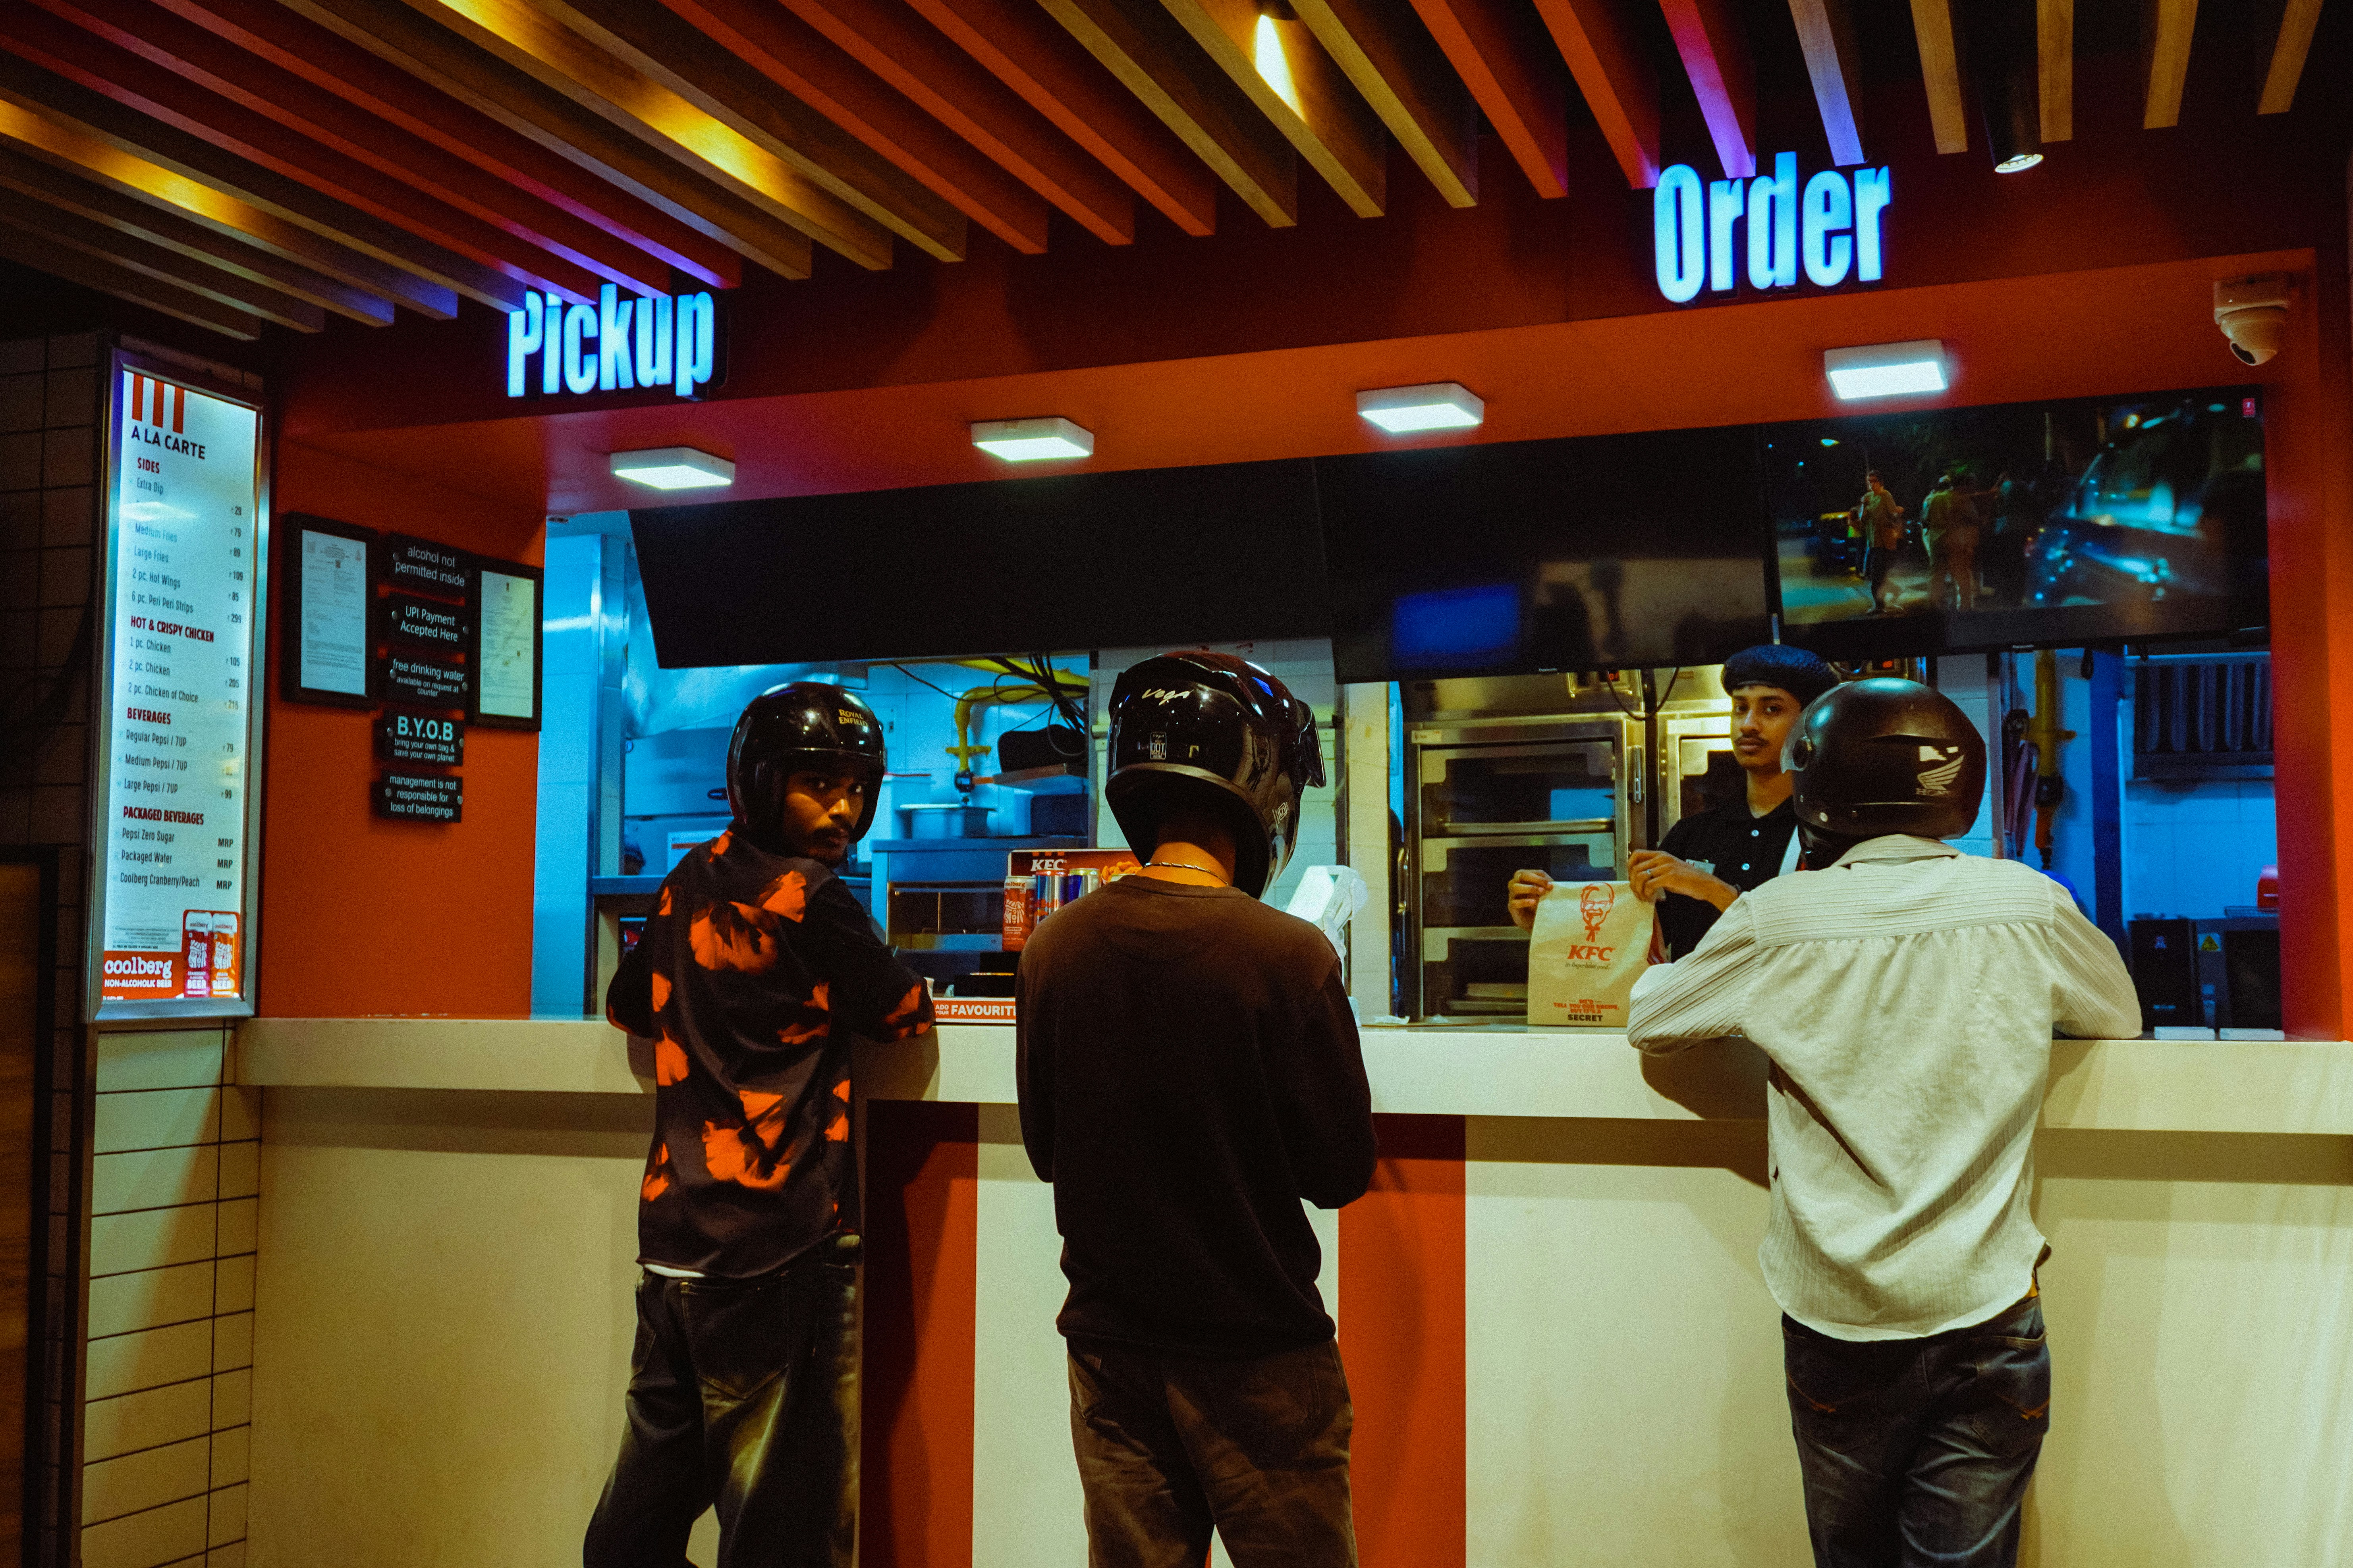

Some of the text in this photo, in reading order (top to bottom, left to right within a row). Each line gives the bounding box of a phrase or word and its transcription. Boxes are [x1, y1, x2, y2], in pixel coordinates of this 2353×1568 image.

[1654, 151, 1890, 303] Order
[508, 283, 714, 397] Pickup
[131, 425, 206, 460] A LA CARTE
[137, 457, 160, 474] SIDES
[137, 477, 164, 496] Extra Dip
[135, 523, 178, 542] Medium Fries
[134, 545, 169, 563] Large Fries
[407, 546, 455, 567] alcohol not
[133, 568, 136, 579] 2
[149, 572, 160, 583] Hot
[162, 574, 181, 590] Wings
[395, 561, 465, 587] permitted inside
[132, 591, 135, 601] 6
[149, 594, 160, 606] Peri
[162, 597, 174, 610] Peri
[176, 600, 193, 615] Strips
[405, 605, 455, 626] UPI Payment
[131, 615, 214, 643] HOT & CRISPY CHICKEN
[400, 620, 458, 642] Accepted Here
[130, 636, 133, 647] 1
[146, 639, 171, 654] Chicken
[129, 659, 133, 670] 2
[146, 662, 170, 676] Chicken
[393, 658, 465, 681] free drinking water
[128, 682, 132, 692] 2
[145, 685, 170, 699] Chicken
[171, 689, 178, 700] of
[179, 690, 198, 703] Choice
[396, 676, 422, 687] available
[432, 683, 452, 692] request
[417, 688, 438, 698] counter
[127, 707, 171, 725] BEVERAGES
[838, 709, 864, 719] ROYAL
[838, 716, 869, 727] ENFIELD
[126, 729, 150, 743] Regular
[152, 733, 169, 746] Pepsi
[176, 736, 187, 747] 7UP
[397, 716, 454, 742] B.Y.O.B
[394, 738, 409, 749] bring
[411, 741, 423, 750] your
[438, 743, 449, 754] bag
[450, 744, 455, 753] &
[125, 754, 151, 767] Medium
[153, 757, 170, 770] Pepsi
[176, 760, 187, 771] 7UP
[410, 751, 423, 759] your
[437, 753, 454, 763] planet
[124, 778, 141, 792] Large
[143, 780, 160, 794] Pepsi
[167, 783, 178, 794] 7UP
[390, 775, 456, 790] management is not
[397, 790, 449, 802] responsible for
[123, 806, 204, 825] PACKAGED BEVERAGES
[390, 801, 454, 819] loss of belongings
[122, 827, 174, 845] Pepsi Zero Sugar
[218, 837, 234, 848] MRP
[122, 849, 172, 864] Packaged Water
[217, 859, 233, 868] MRP
[1030, 859, 1066, 872] KFC
[120, 872, 148, 887] Coolberg
[216, 880, 232, 890] MRP
[1567, 945, 1614, 961] KFC
[104, 957, 172, 979] coolberg
[104, 979, 156, 987] NON-ALCOHOLIC
